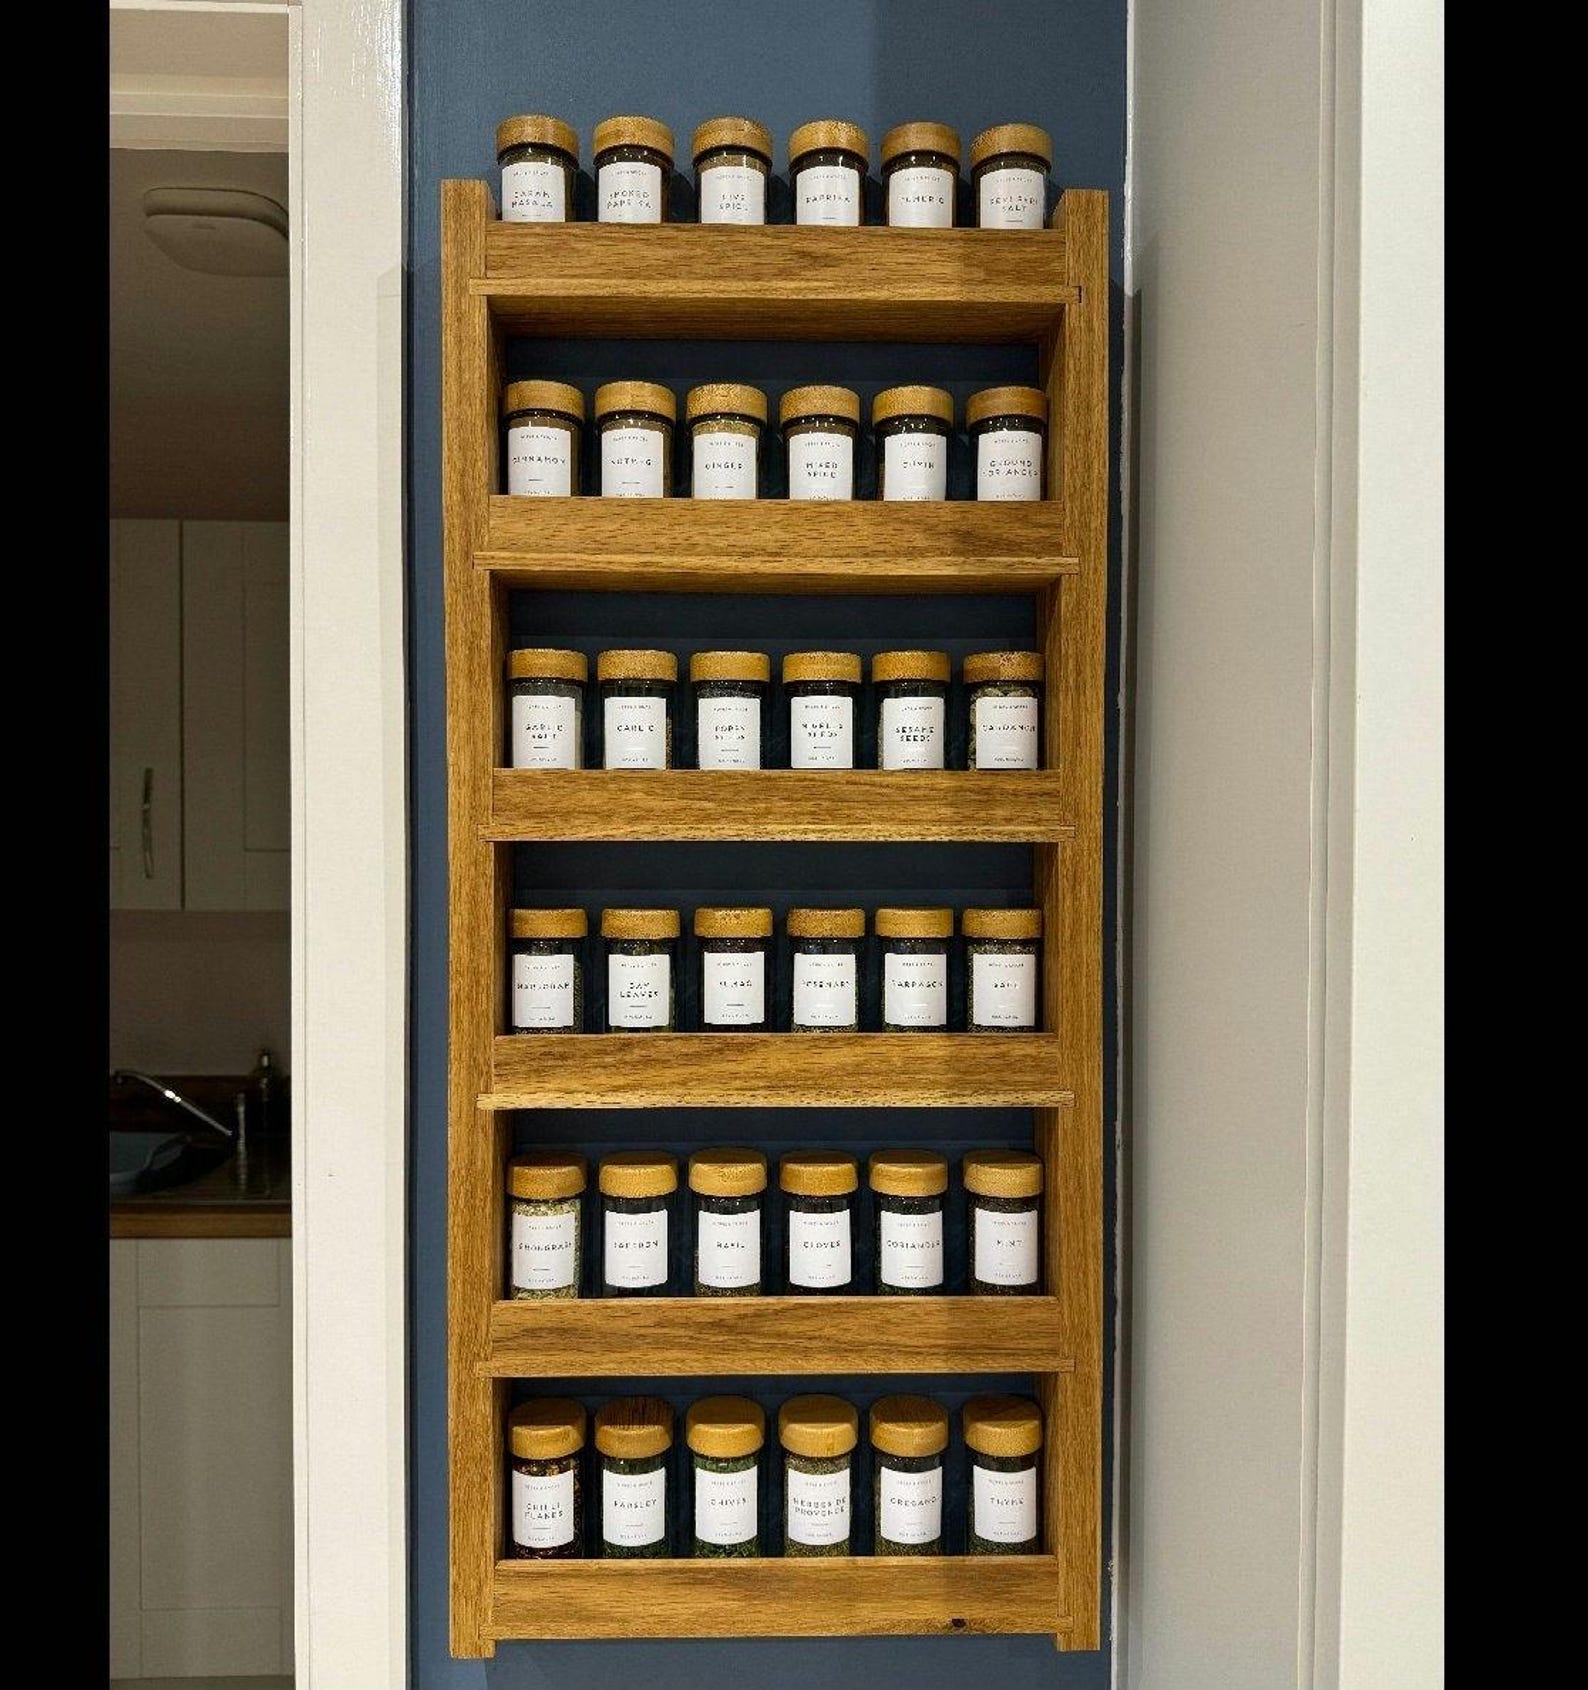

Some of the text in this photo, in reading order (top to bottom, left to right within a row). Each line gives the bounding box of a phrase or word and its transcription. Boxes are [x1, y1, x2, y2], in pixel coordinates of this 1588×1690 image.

[606, 200, 652, 209] PAPRKA
[525, 723, 564, 732] GARLC
[616, 723, 655, 732] GARLC
[802, 980, 851, 989] OSEMARY
[995, 1239, 1023, 1248] MNT
